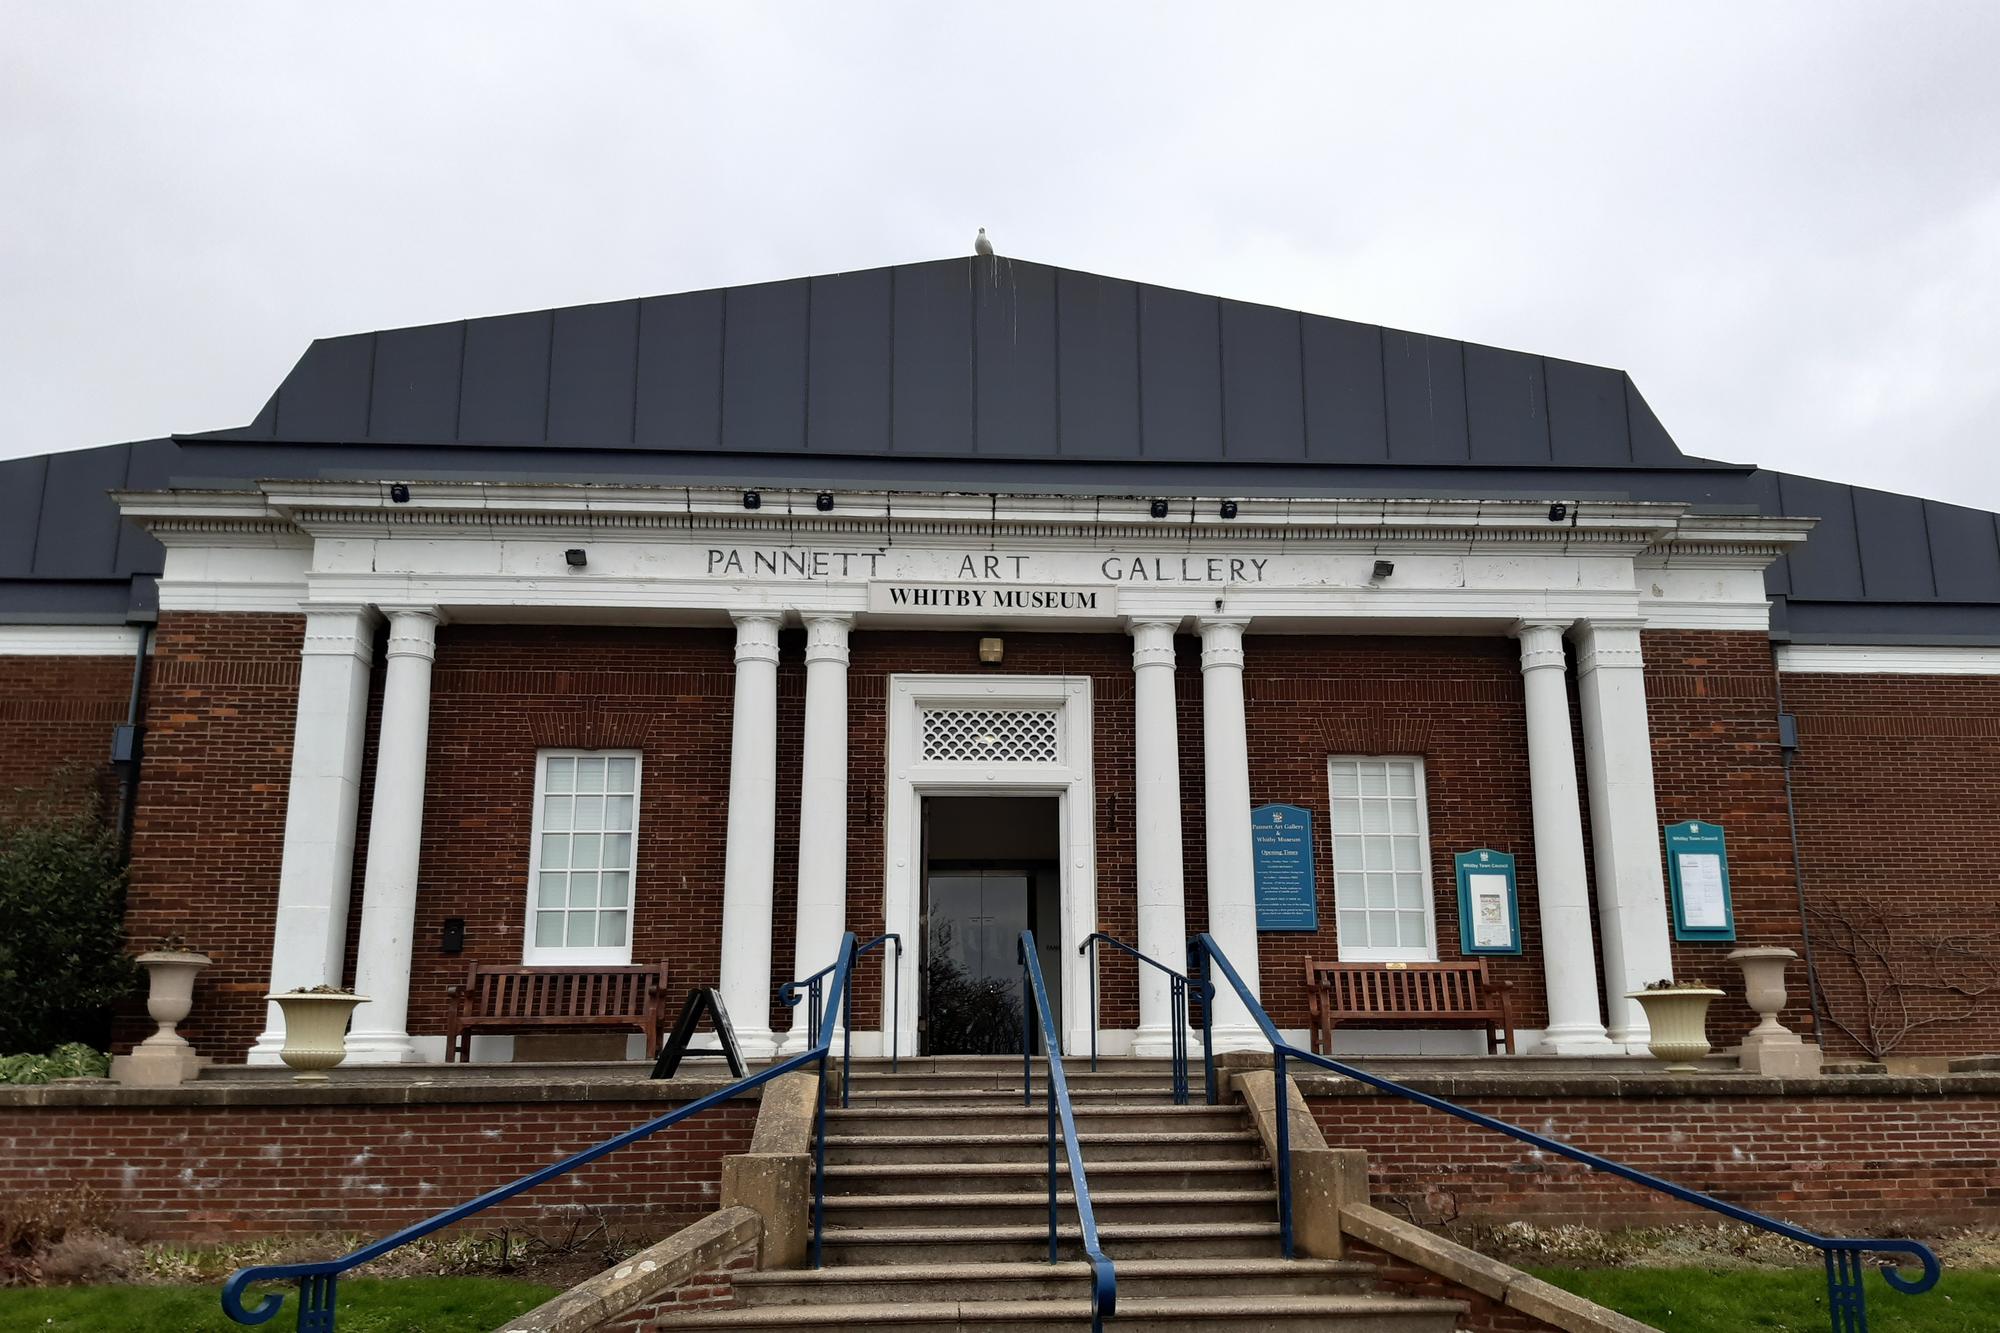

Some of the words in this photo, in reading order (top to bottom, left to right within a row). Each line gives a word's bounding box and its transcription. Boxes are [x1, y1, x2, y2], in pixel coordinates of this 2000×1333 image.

[707, 549, 887, 577] PANNETT
[957, 553, 1031, 580] ART
[1101, 556, 1269, 582] GALLERY
[889, 587, 987, 607] WHITBY
[992, 590, 1098, 609] MUSEUM
